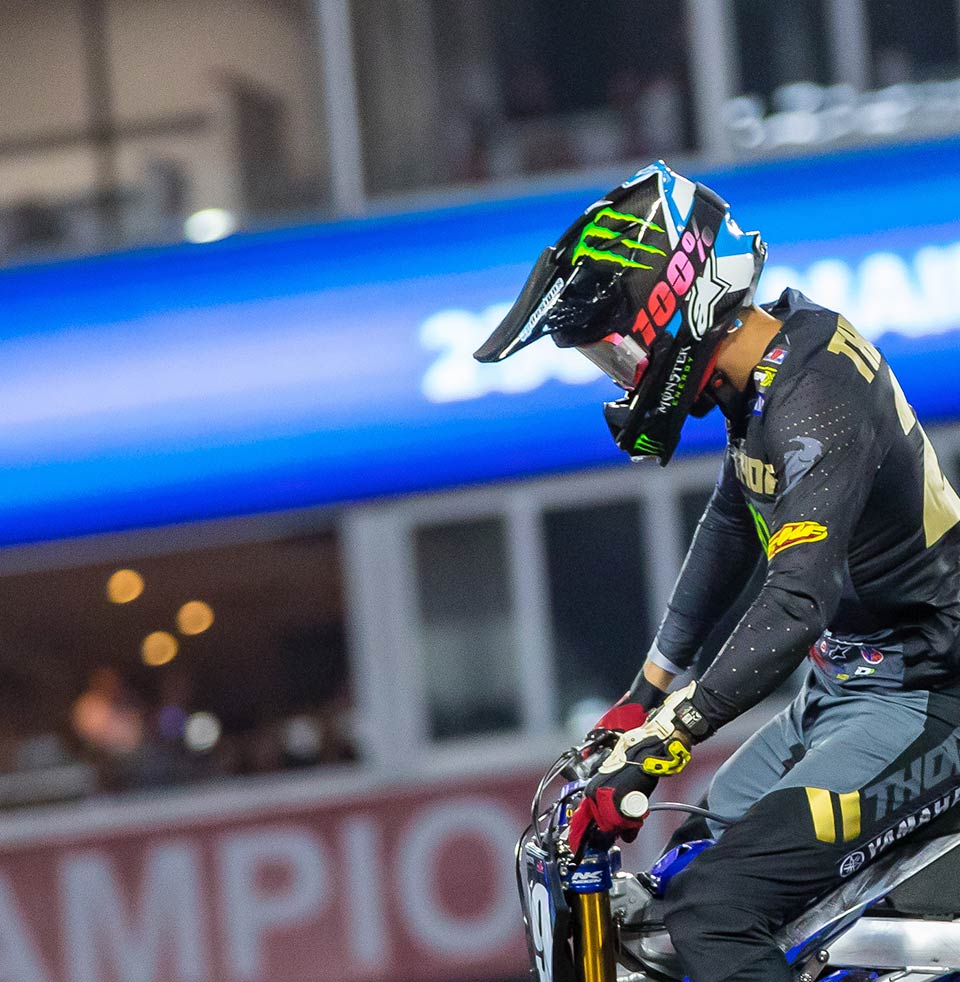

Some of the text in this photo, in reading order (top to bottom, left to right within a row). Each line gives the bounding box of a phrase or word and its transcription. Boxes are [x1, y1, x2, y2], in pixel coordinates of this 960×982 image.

[631, 221, 713, 347] 100%
[656, 345, 692, 414] MONSTER
[671, 355, 695, 407] ENERGY
